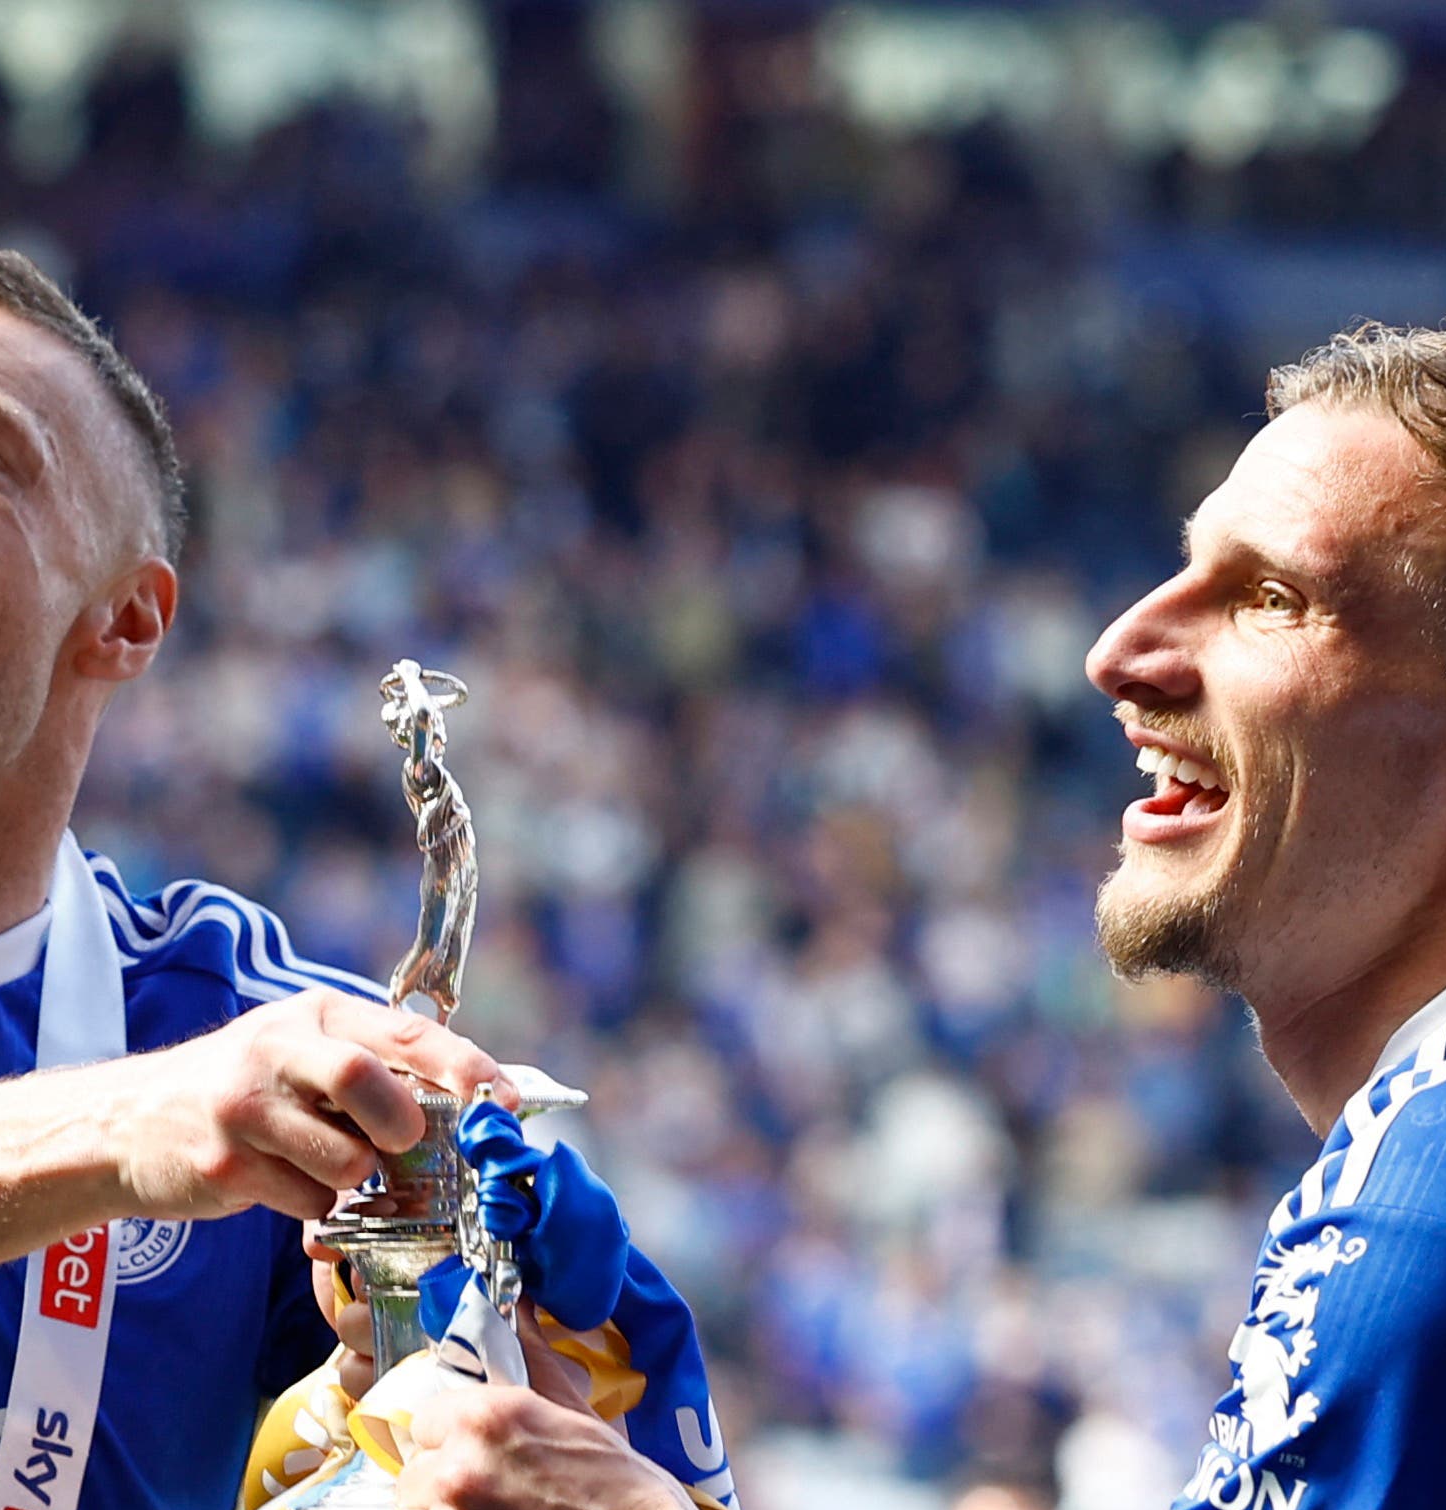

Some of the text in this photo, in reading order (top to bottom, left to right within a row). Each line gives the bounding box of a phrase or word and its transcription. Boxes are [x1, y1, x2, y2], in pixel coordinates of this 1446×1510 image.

[54, 1227, 105, 1313] bet
[130, 1226, 173, 1267] CLUB
[14, 1407, 73, 1506] sky
